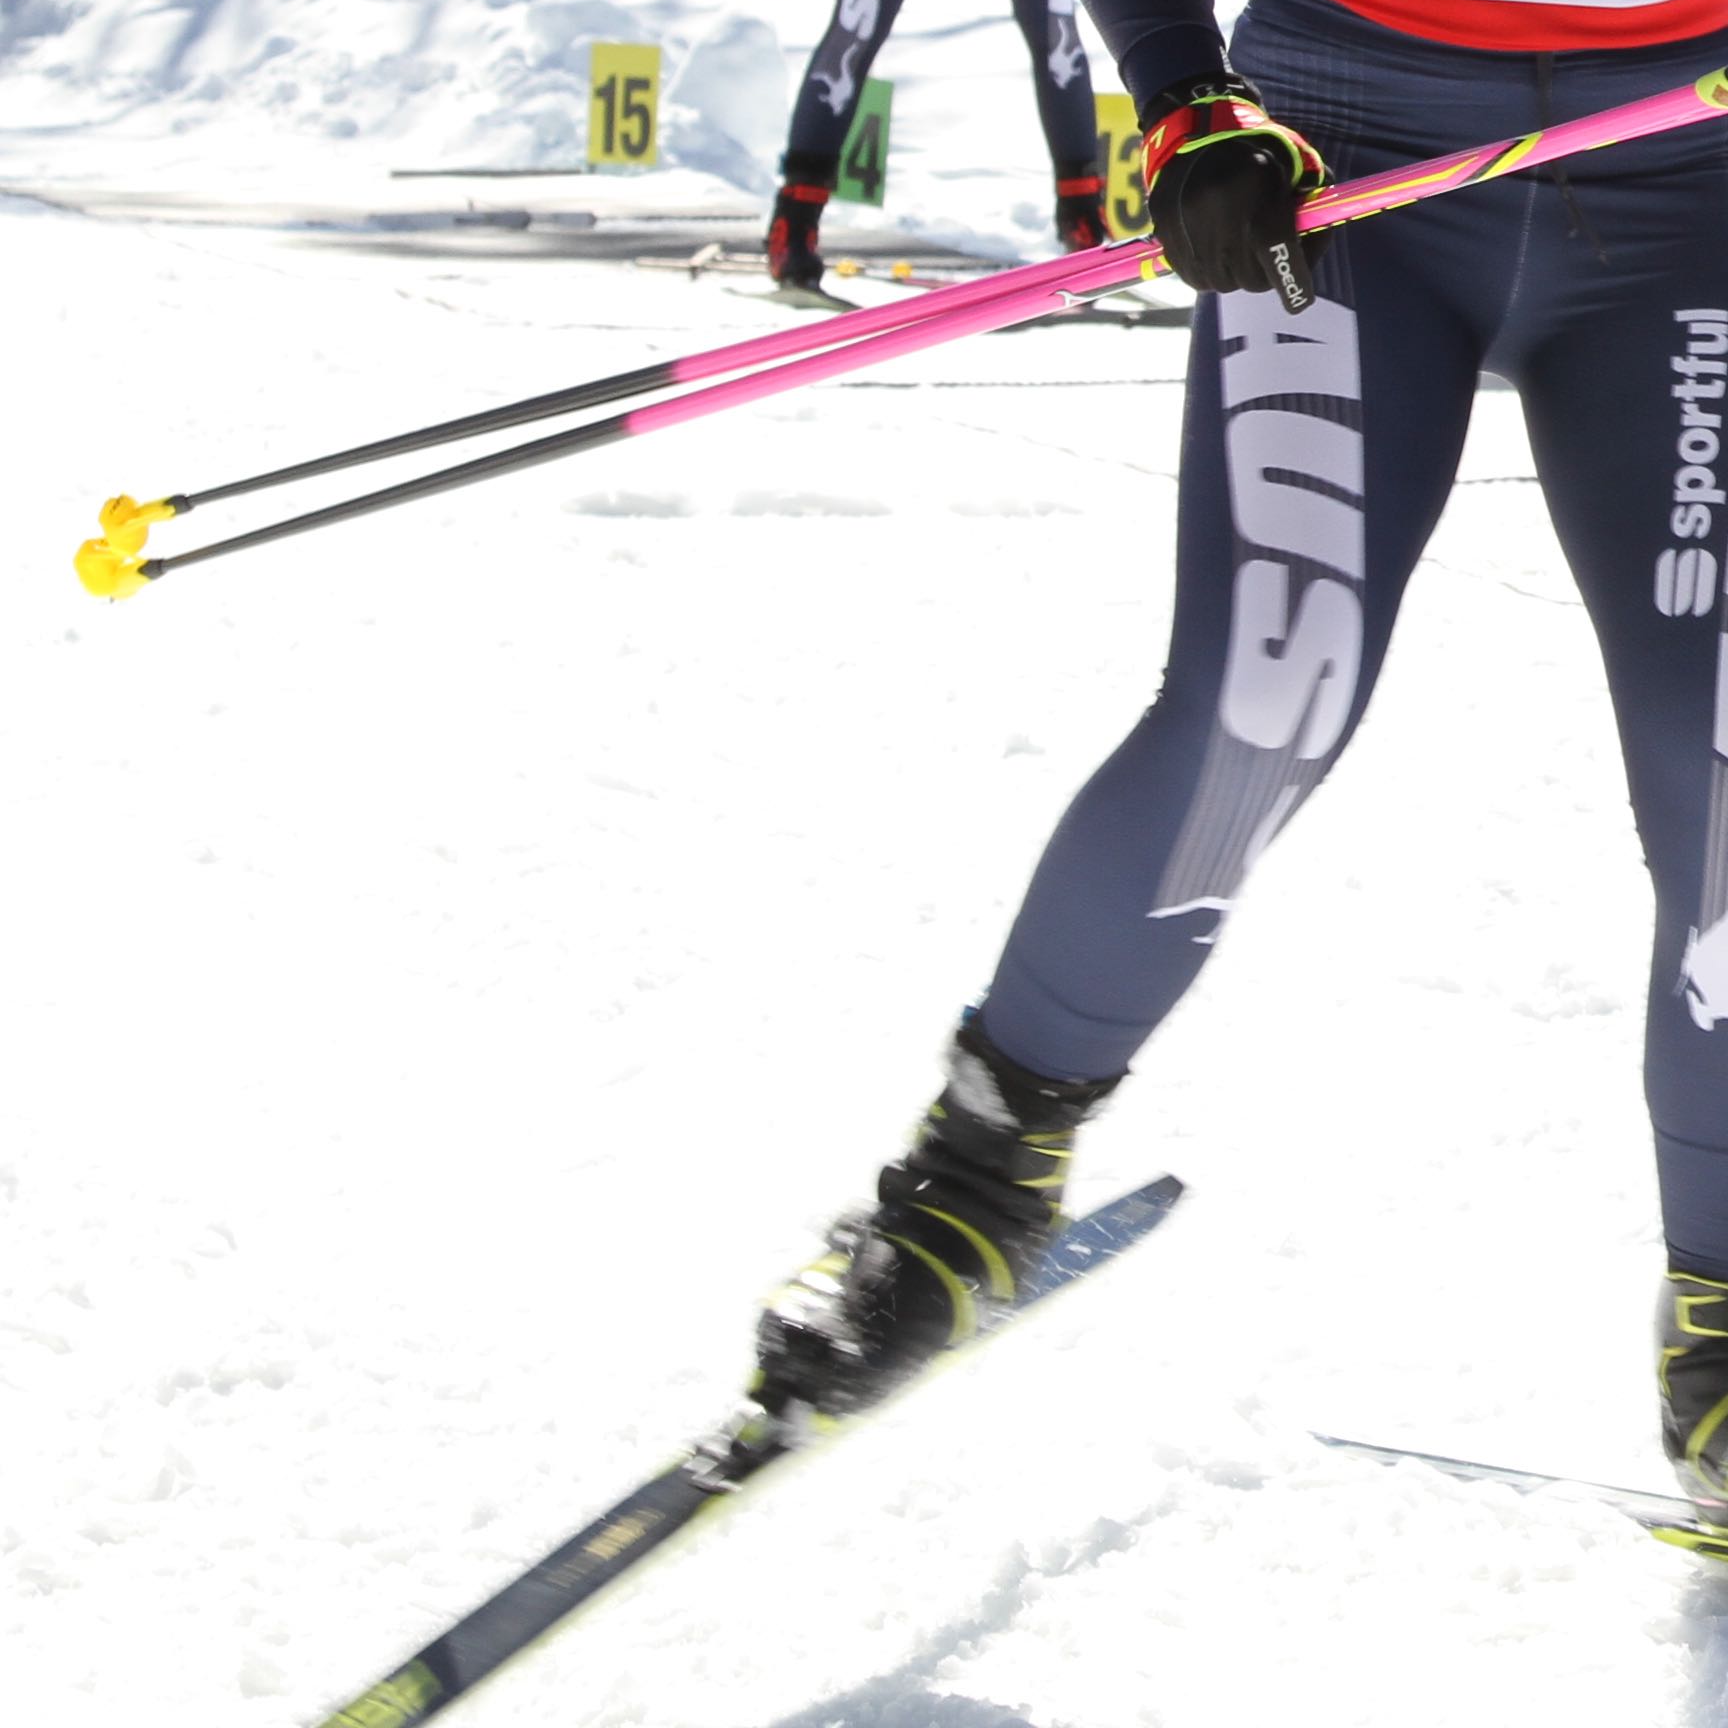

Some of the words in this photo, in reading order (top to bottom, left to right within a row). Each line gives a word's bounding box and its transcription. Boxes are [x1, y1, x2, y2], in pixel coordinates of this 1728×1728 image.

[592, 74, 652, 159] 15
[1269, 241, 1308, 309] Roeckl
[1216, 284, 1367, 761] AUS
